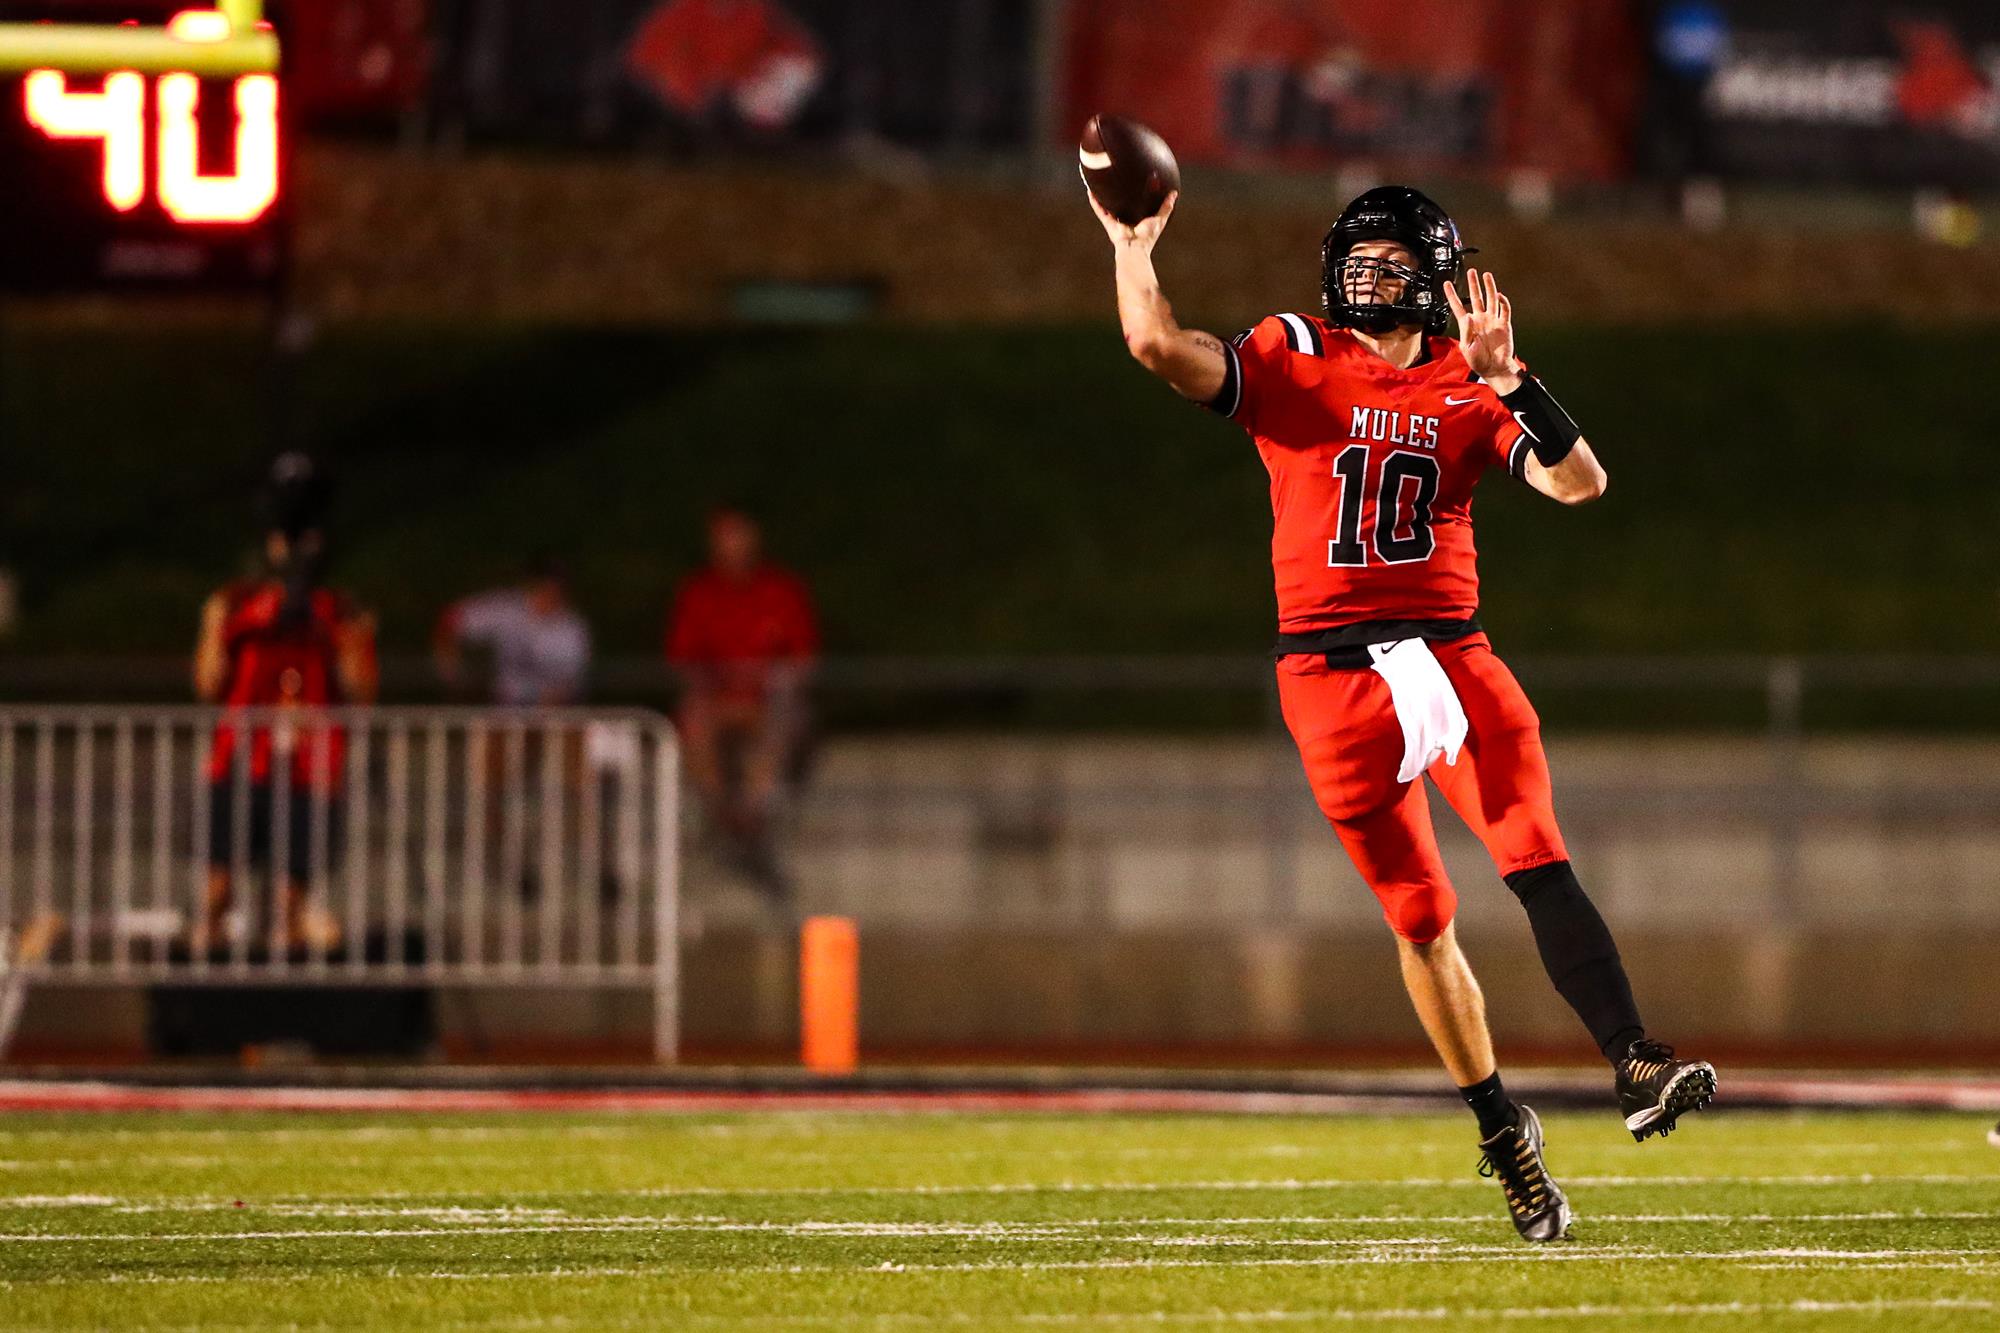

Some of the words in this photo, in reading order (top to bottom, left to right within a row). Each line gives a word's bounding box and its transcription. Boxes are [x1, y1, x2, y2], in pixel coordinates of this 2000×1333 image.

[25, 12, 279, 223] 40
[1350, 406, 1439, 449] MULES
[1328, 443, 1441, 567] 10
